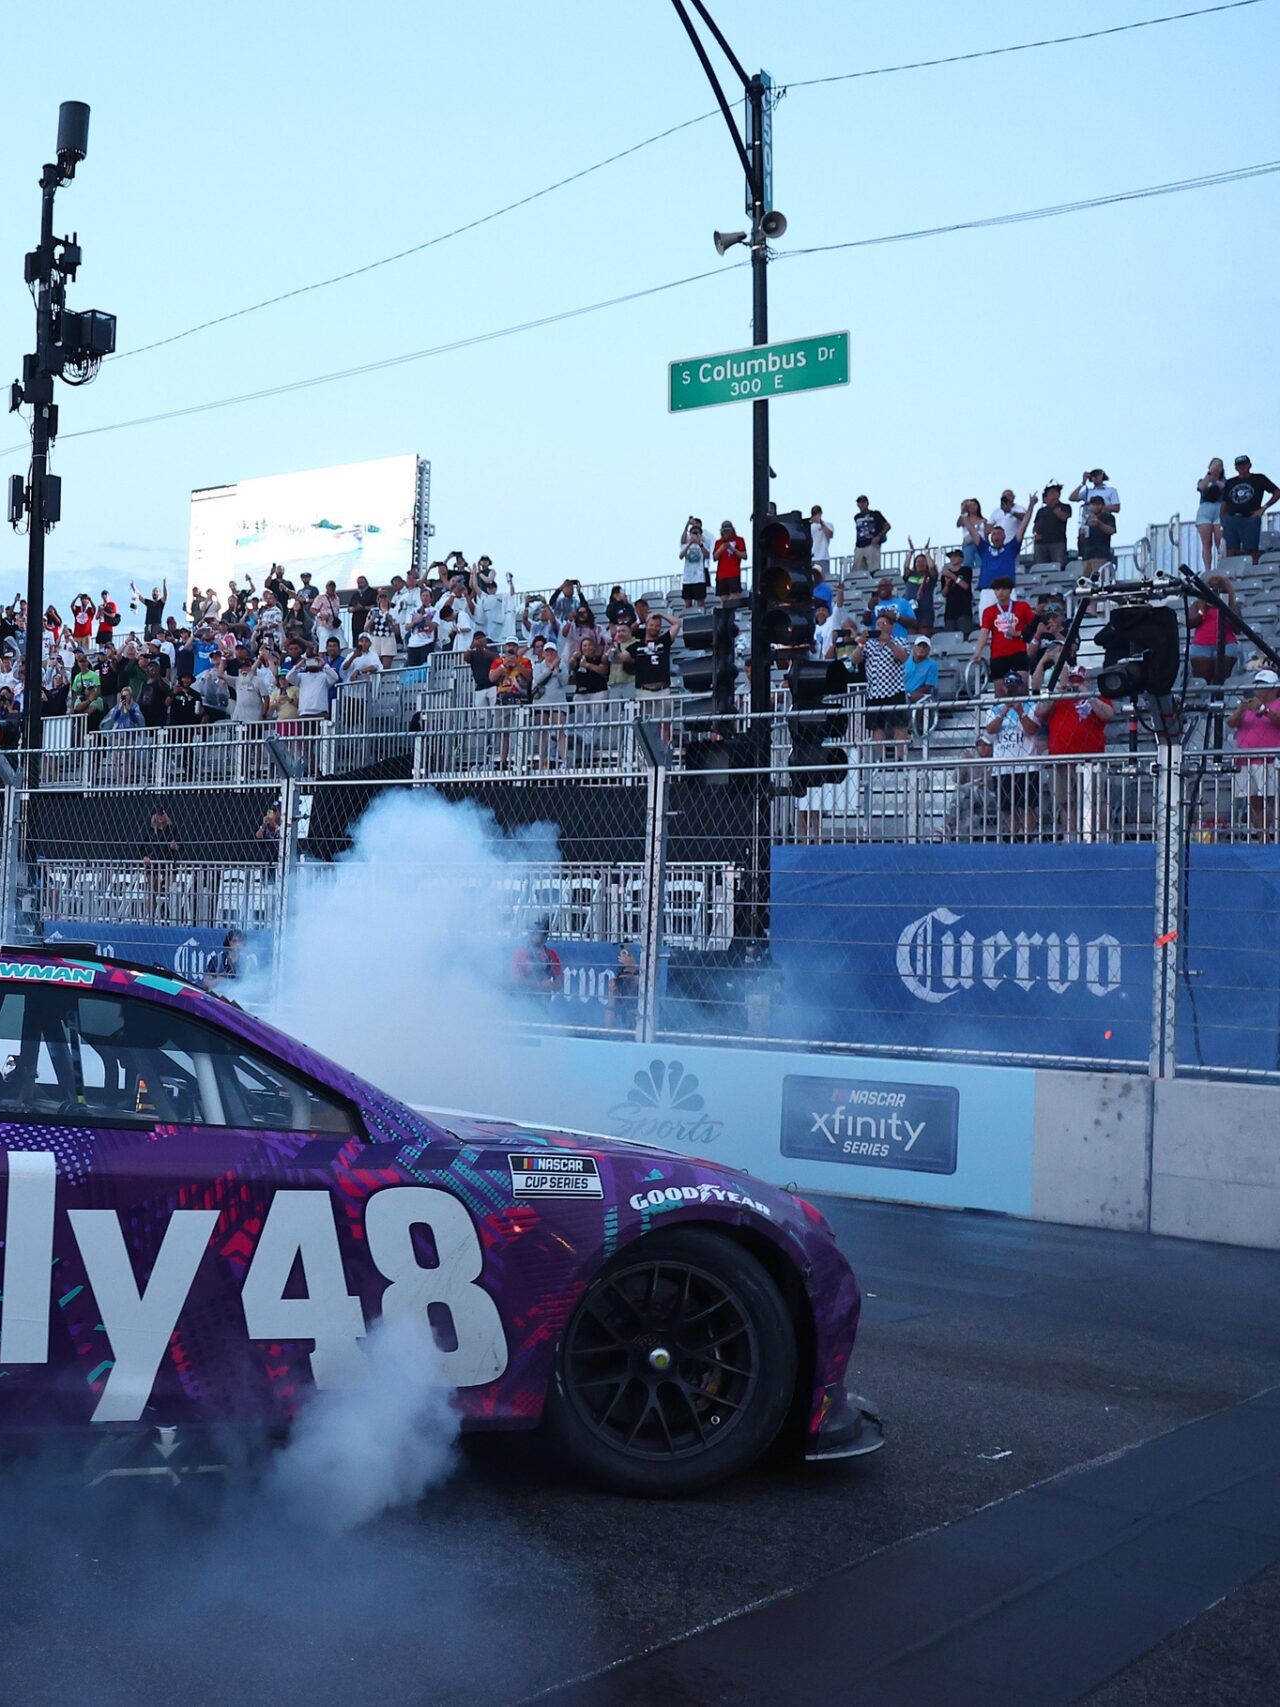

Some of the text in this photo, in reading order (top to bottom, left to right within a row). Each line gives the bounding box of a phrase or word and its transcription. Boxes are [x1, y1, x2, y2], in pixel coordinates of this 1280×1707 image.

[682, 346, 835, 385] S Columbus Dr
[730, 374, 784, 396] 300 E
[896, 907, 1121, 1003] Cuervo
[849, 1089, 906, 1108] NASCAR
[810, 1106, 926, 1151] xfinity
[842, 1140, 890, 1157] SERIES
[537, 1158, 584, 1172] NASCAR
[524, 1176, 589, 1189] CUP SERIES
[629, 1184, 771, 1216] GOODYEAR
[241, 1186, 508, 1390] 48
